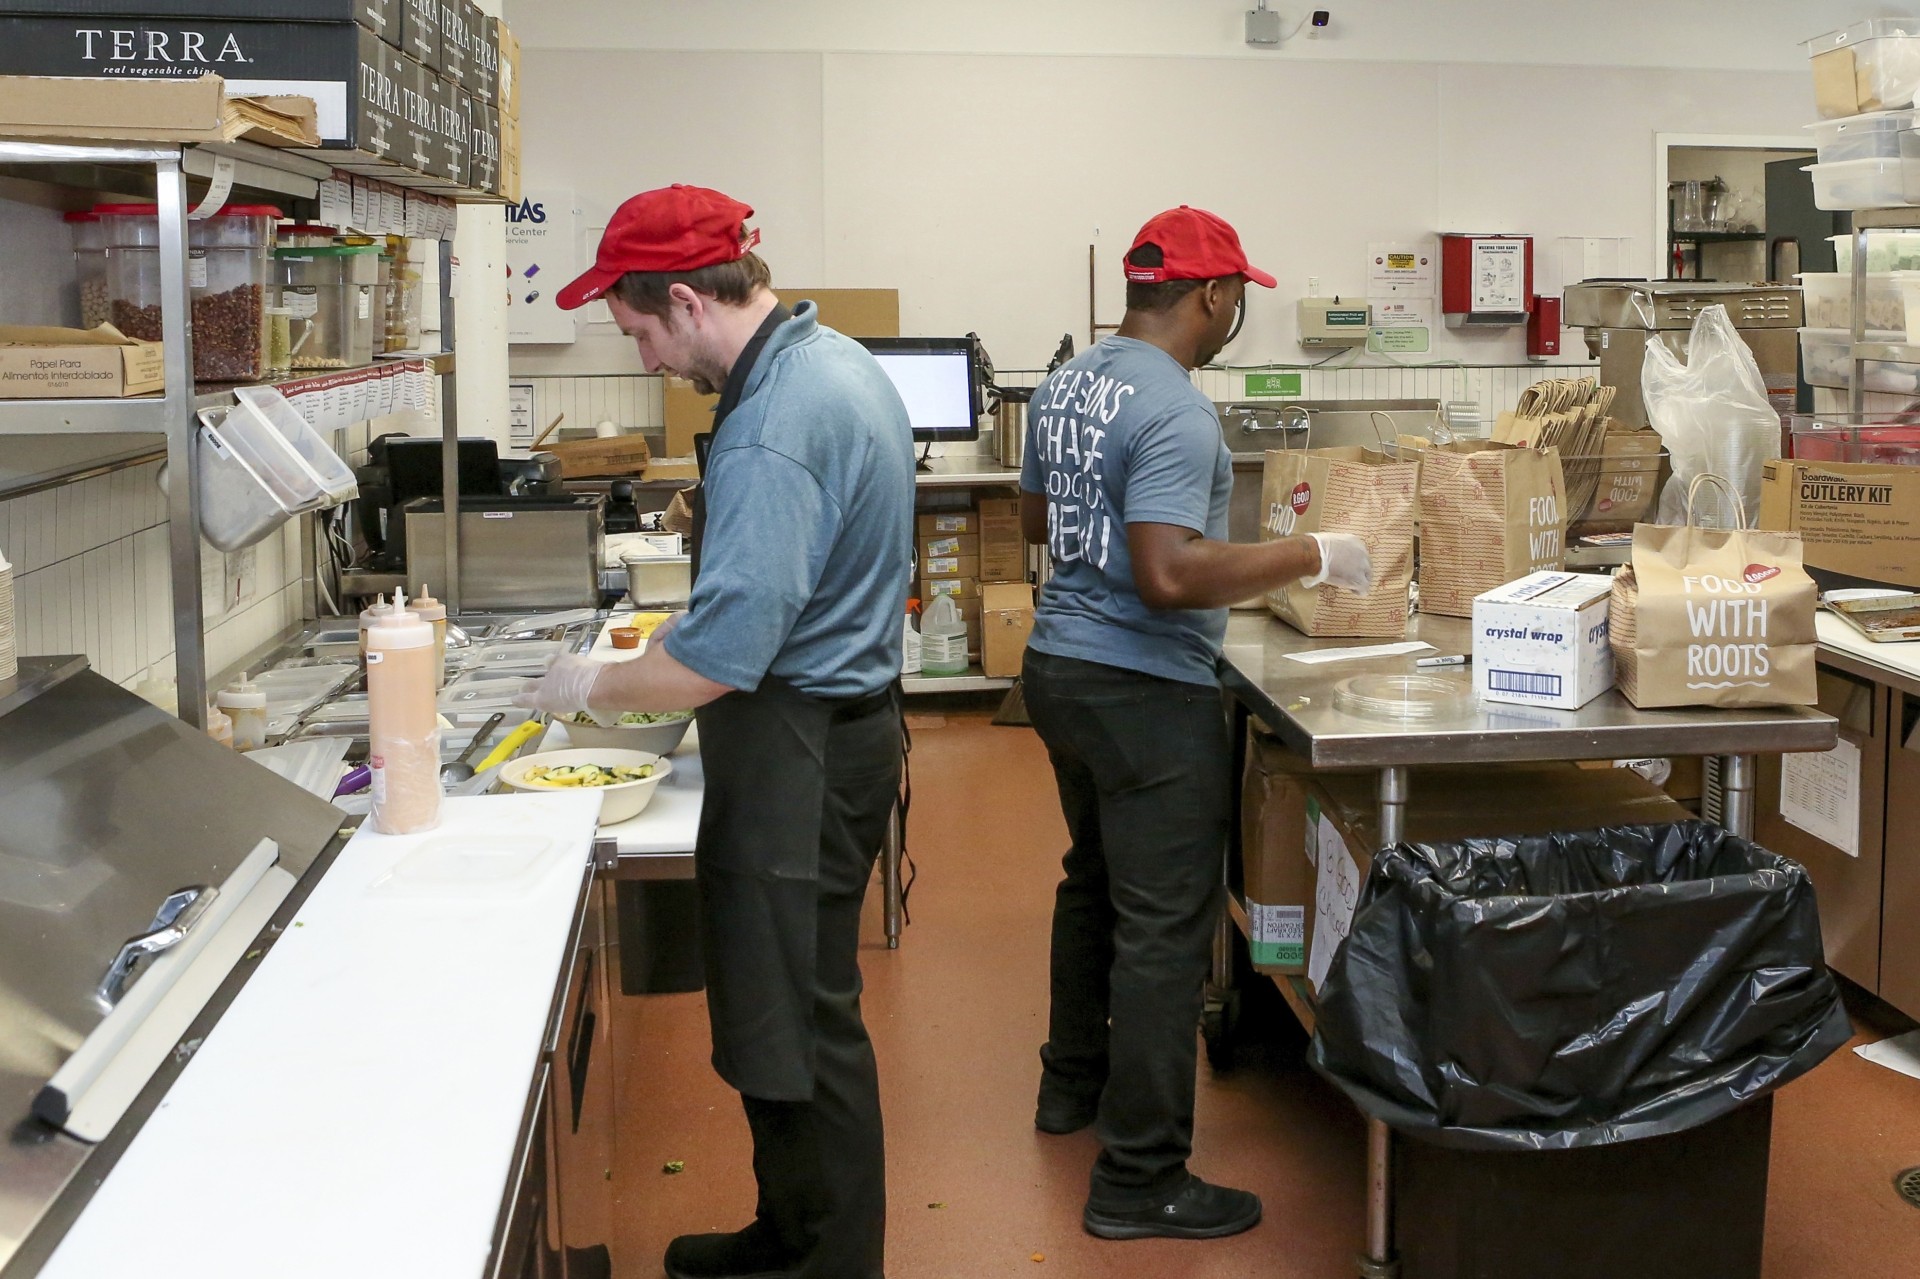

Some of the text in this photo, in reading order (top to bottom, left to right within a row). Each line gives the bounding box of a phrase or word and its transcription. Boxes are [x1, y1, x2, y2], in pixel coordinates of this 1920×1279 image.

[407, 0, 439, 25] ERRA
[441, 4, 470, 51] TERRA
[76, 30, 247, 62] TERRA
[472, 34, 498, 72] ERRA
[103, 66, 126, 74] real
[130, 66, 182, 76] vegetable
[361, 62, 400, 117] TERRA
[403, 87, 438, 133] TERRA
[440, 104, 467, 144] TERRA
[512, 227, 547, 236] Center
[2, 371, 114, 381] Alimentos Interdoblado
[30, 359, 81, 369] Papel Para
[1040, 370, 1135, 425] SEASONS
[1610, 487, 1641, 502] FOOD
[1800, 484, 1893, 503] CUTLERY KIT
[1267, 502, 1297, 536] FOOD
[1530, 529, 1560, 561] WITH
[1682, 575, 1763, 594] FOOD
[1686, 599, 1768, 638] WITH
[1485, 627, 1563, 644] crystal wrap
[1687, 643, 1770, 677] ROOTS
